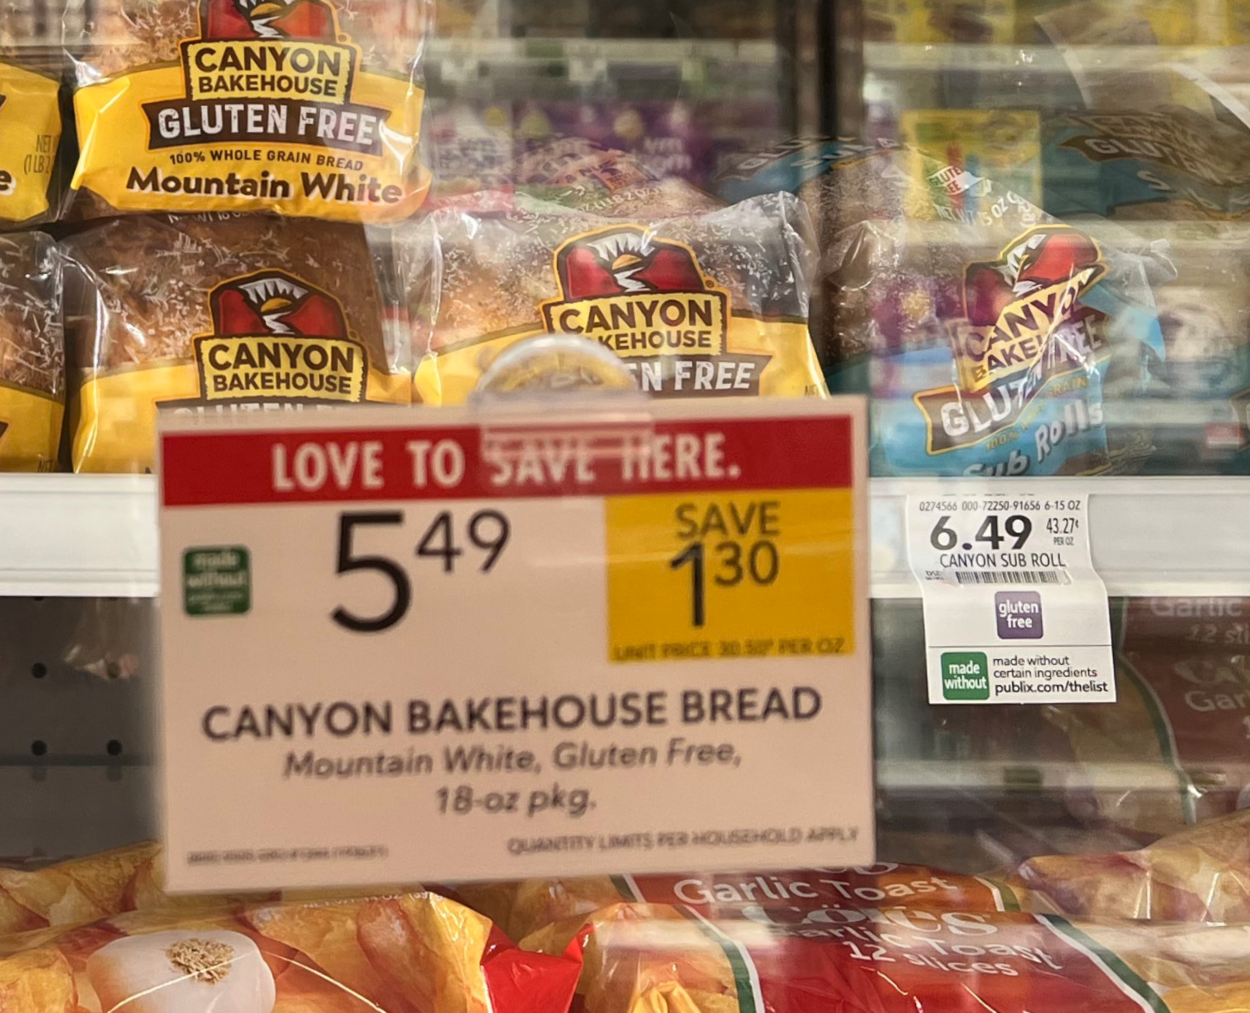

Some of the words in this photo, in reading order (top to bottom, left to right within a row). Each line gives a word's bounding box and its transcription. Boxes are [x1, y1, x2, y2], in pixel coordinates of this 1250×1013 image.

[195, 47, 340, 77] CANYON
[198, 74, 337, 97] BAKEHOUSE
[158, 104, 287, 139] GLUTEN
[297, 107, 379, 145] FREE
[126, 166, 292, 201] Mountain
[300, 171, 404, 204] White
[559, 300, 713, 335] CANYON
[208, 342, 354, 374] CANYON
[213, 372, 352, 395] BAKEHOUSE
[674, 361, 756, 392] FREE
[1035, 398, 1104, 463] Rolls
[272, 441, 384, 492] LOVE
[406, 439, 464, 488] TO
[488, 436, 596, 486] SAVE
[620, 432, 742, 482] HERE.
[674, 500, 781, 540] SAVE
[930, 514, 1032, 550] 6.49
[999, 600, 1039, 617] gluten
[944, 676, 987, 690] without
[949, 661, 980, 674] made
[993, 668, 1032, 678] certain
[1034, 668, 1098, 680] ingredients
[995, 681, 1108, 696] publix.com/thelist
[202, 699, 392, 742] CANYON
[407, 691, 667, 735] BAKEHOUSE
[681, 686, 822, 723] BREAD
[283, 747, 433, 780] Mountain
[442, 744, 541, 775] White,
[552, 740, 658, 771] Gluten
[666, 737, 741, 768] Free,
[434, 785, 519, 815] 18-oz
[527, 782, 597, 818] pkg.
[673, 875, 819, 905] Garlic
[820, 876, 958, 901] Toast
[842, 940, 896, 963] 12
[903, 953, 1019, 977] slices
